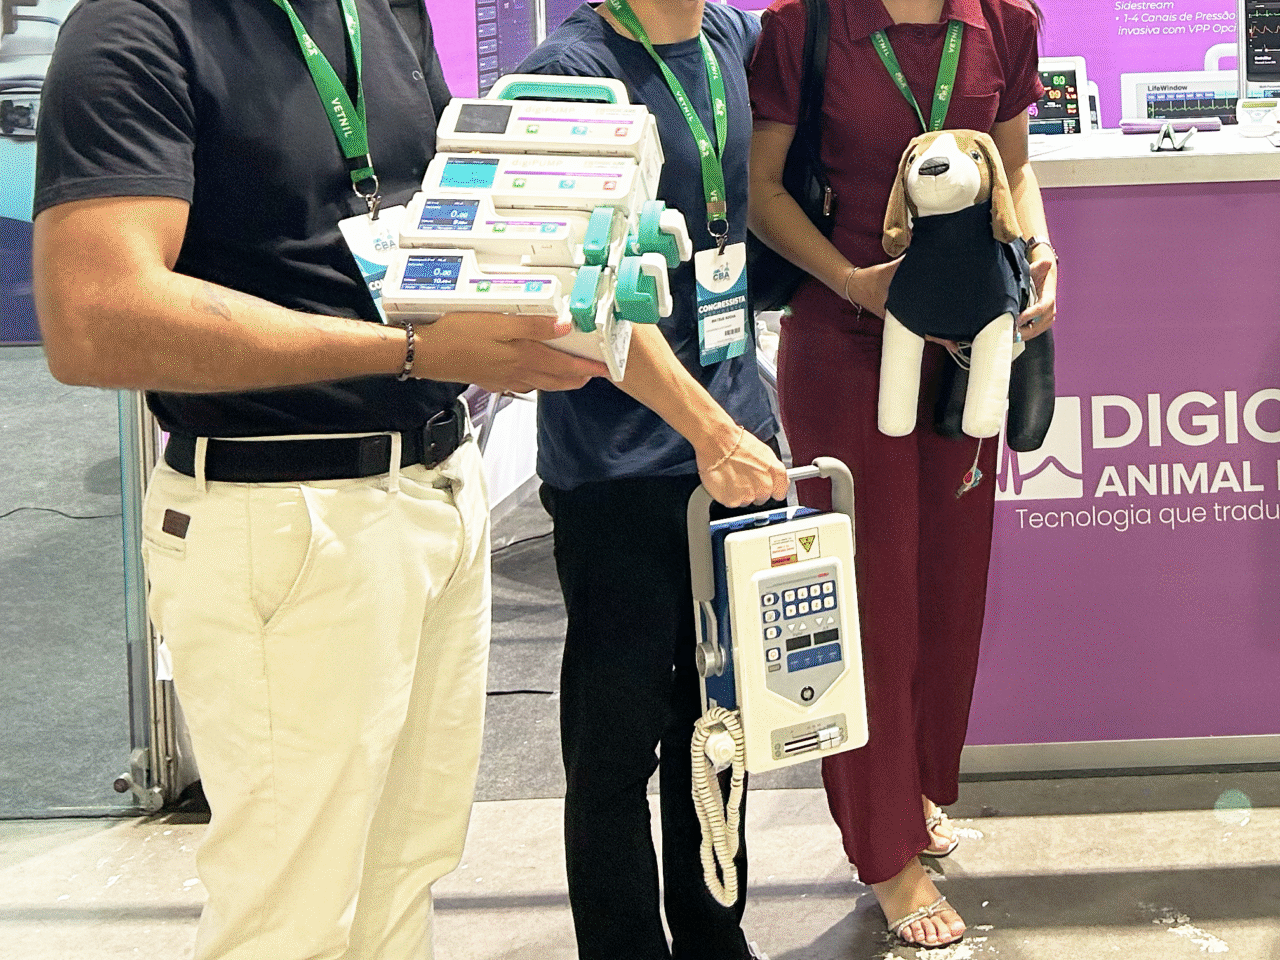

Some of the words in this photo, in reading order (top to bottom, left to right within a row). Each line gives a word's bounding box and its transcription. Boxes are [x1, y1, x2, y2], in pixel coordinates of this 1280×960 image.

[1114, 1, 1174, 11] Sidestream
[1123, 13, 1139, 23] 1-4
[1141, 12, 1177, 23] Canais
[1179, 11, 1193, 21] de
[1195, 10, 1236, 21] Pressão
[1117, 25, 1161, 36] invasiva
[1162, 25, 1186, 35] com
[1188, 24, 1211, 34] VPP
[1147, 84, 1188, 92] LifeWindow
[676, 91, 694, 122] VETNIL
[330, 97, 353, 138] VETNIL
[698, 295, 746, 314] CONGRESSISTA
[1094, 460, 1264, 498] ANIMAL
[1016, 503, 1151, 532] Tecnologia
[1159, 503, 1207, 531] que
